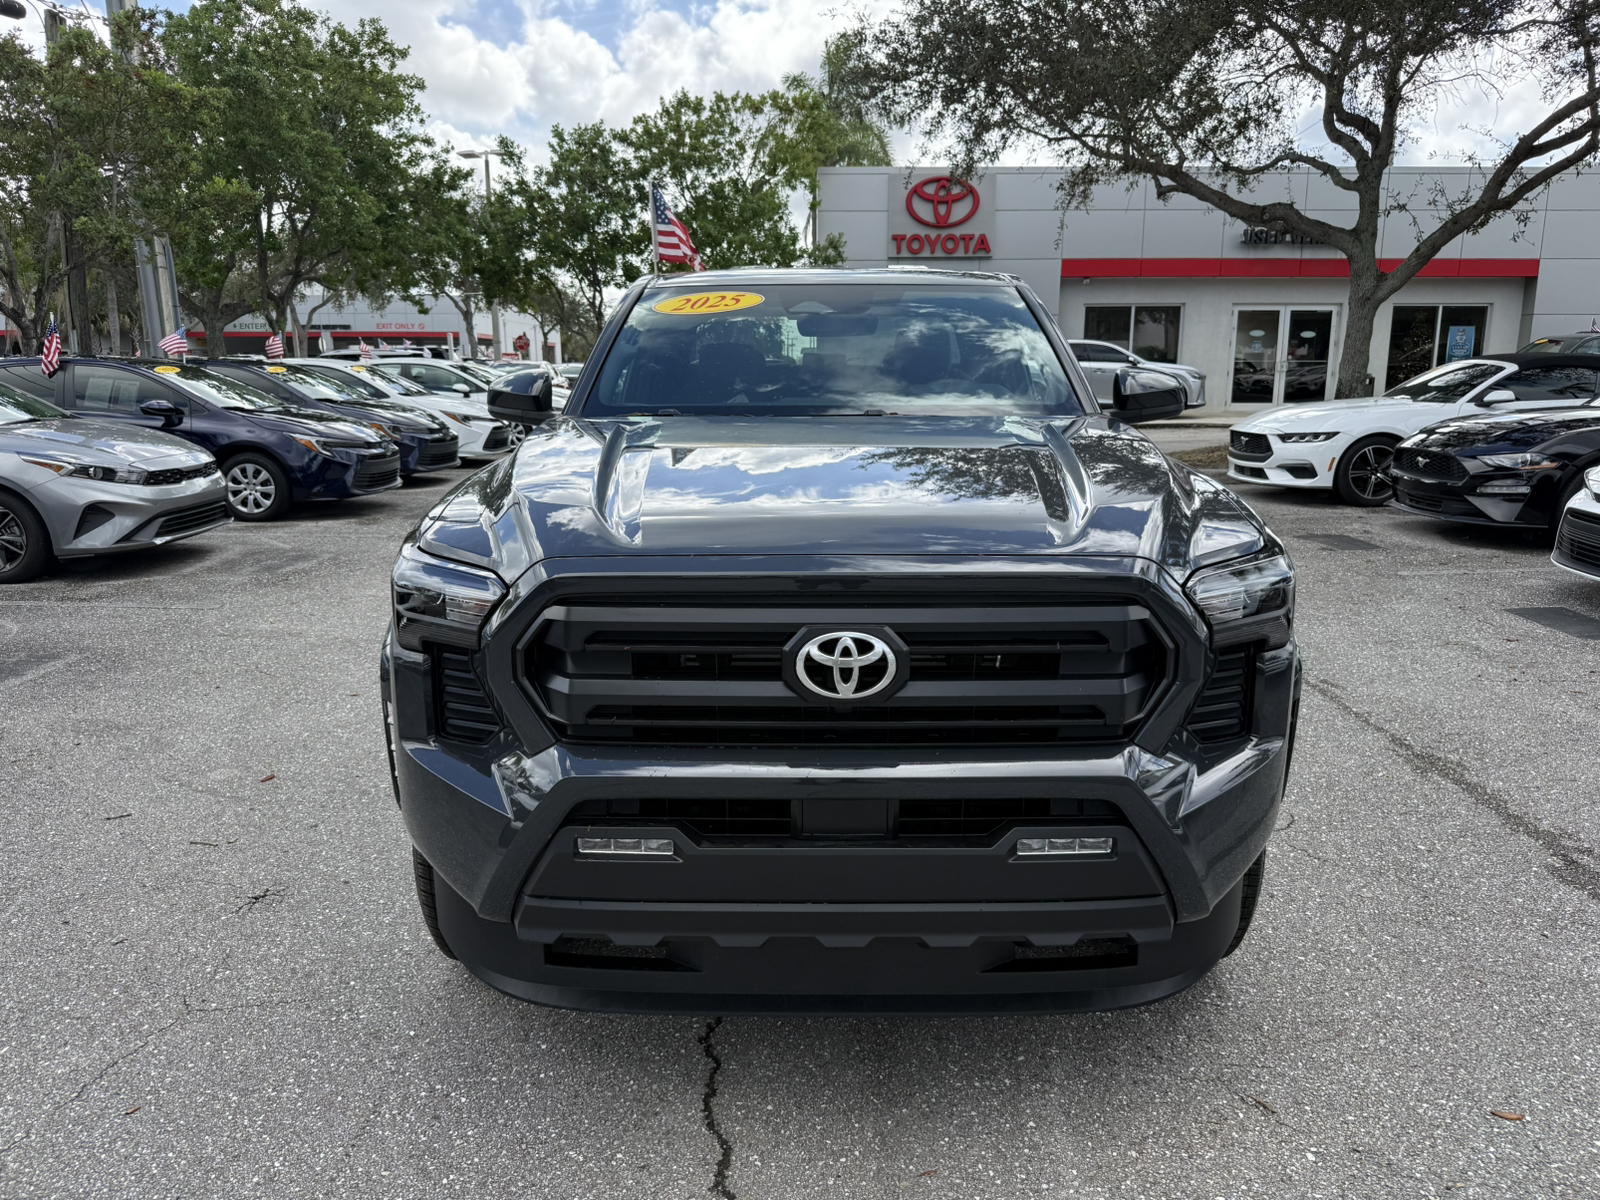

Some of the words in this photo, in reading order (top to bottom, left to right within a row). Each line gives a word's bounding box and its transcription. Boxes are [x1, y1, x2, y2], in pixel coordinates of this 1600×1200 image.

[891, 233, 991, 255] TOYOTA
[670, 294, 746, 312] 2025
[239, 322, 267, 330] ENTER
[376, 322, 393, 330] EXIT
[394, 322, 415, 330] ONLY
